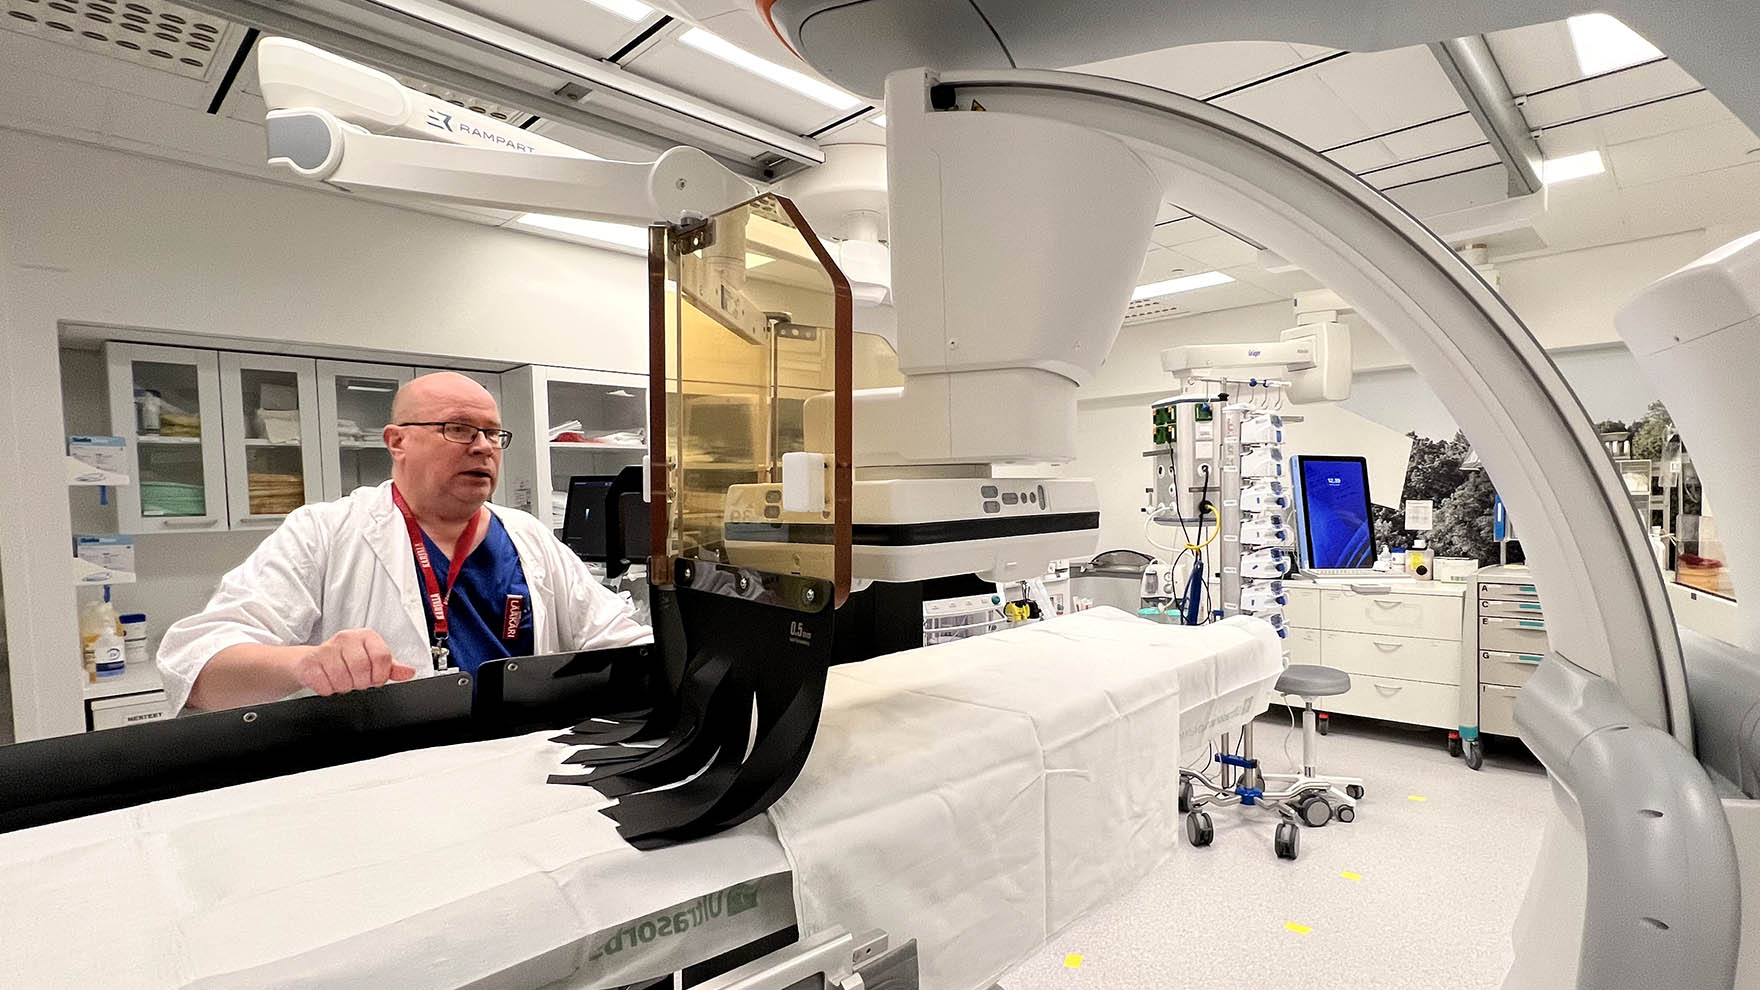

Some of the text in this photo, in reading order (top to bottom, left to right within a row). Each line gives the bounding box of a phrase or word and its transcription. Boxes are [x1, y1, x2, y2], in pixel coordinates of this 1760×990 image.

[459, 123, 535, 153] RAMPART
[1481, 584, 1488, 592] A
[507, 600, 519, 638] LÄÄKÄRI
